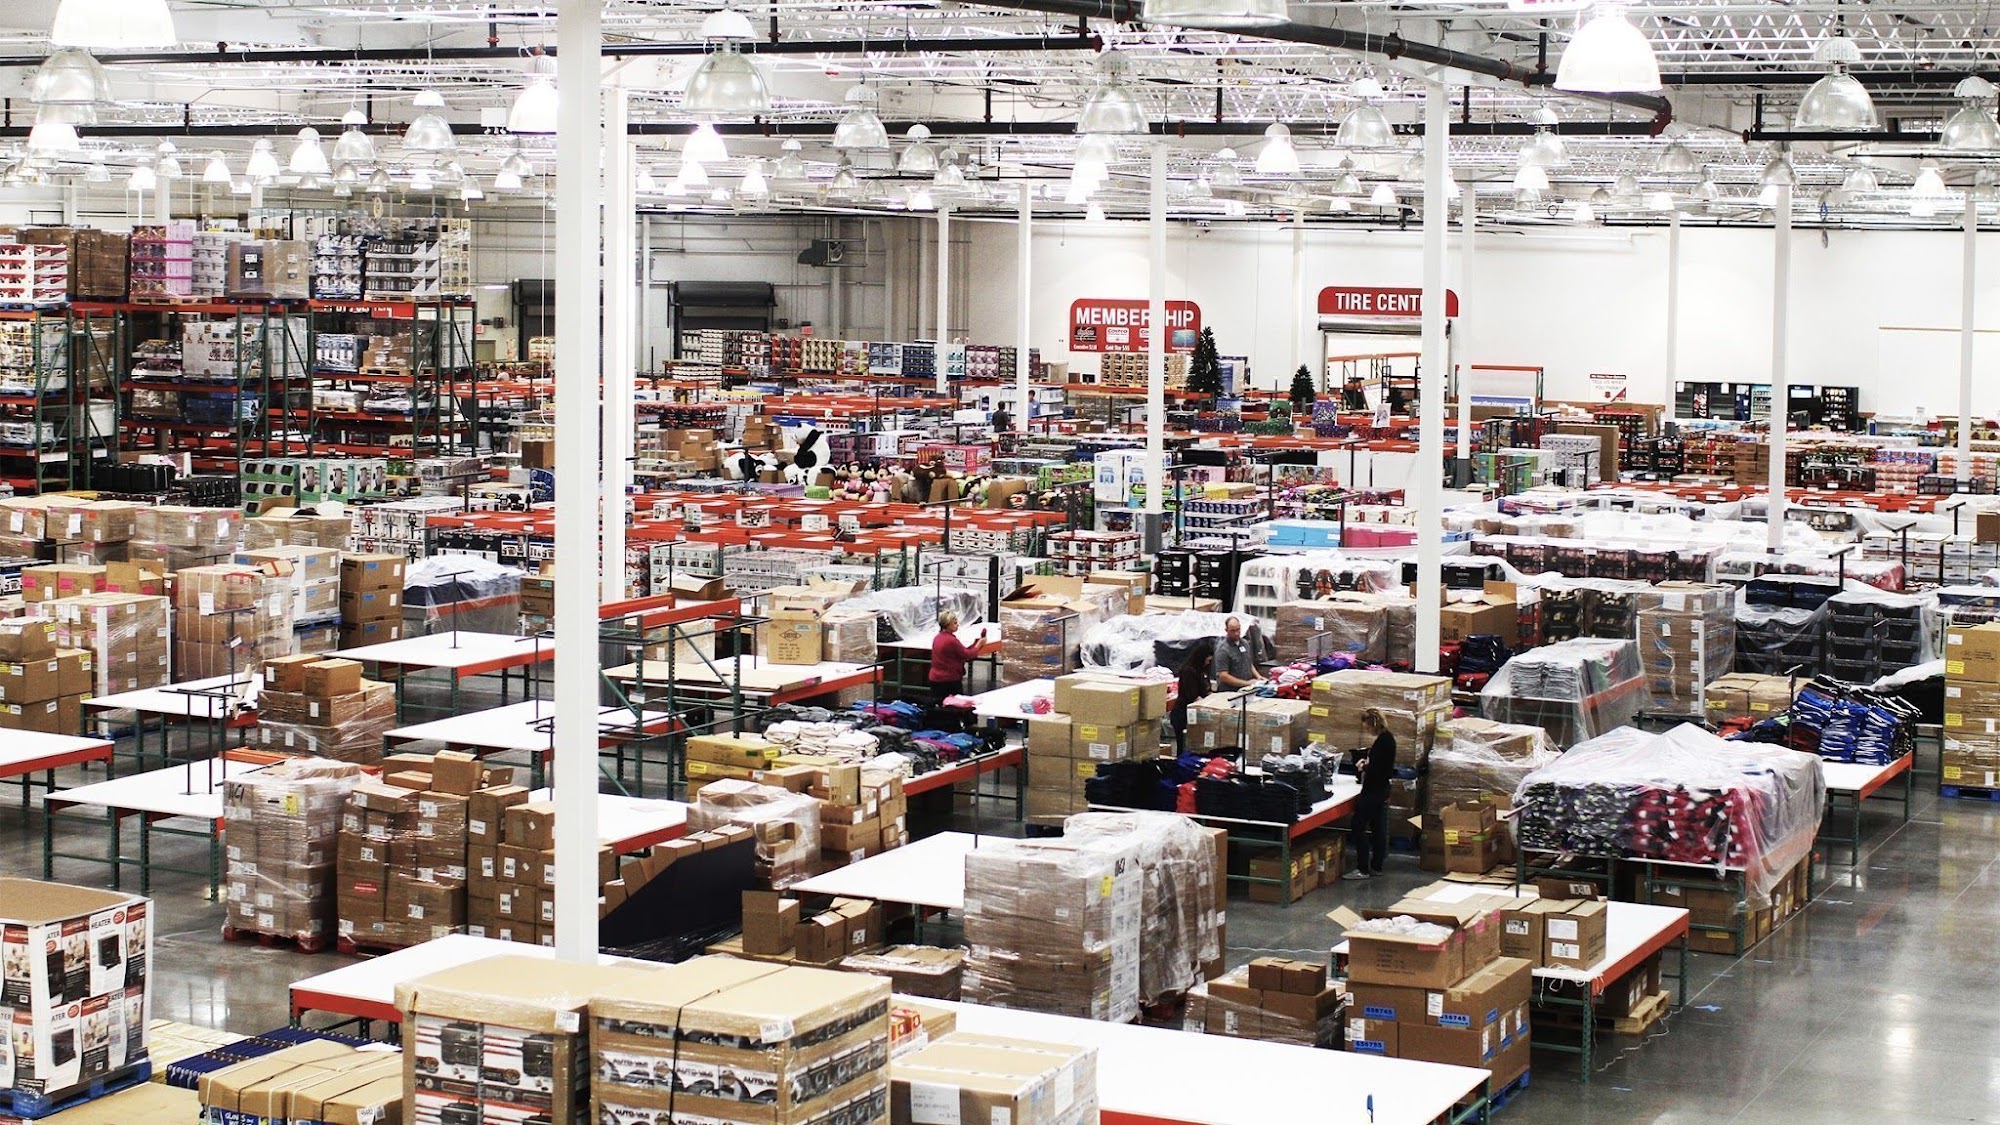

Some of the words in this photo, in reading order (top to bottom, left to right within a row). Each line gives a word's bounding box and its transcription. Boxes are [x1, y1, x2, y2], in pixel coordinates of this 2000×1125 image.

[1335, 293, 1371, 311] TIRE
[1377, 294, 1422, 312] CENT
[1076, 307, 1194, 327] MEMBERHIP
[91, 918, 111, 929] HEATER
[743, 1076, 777, 1086] AUTO-VA
